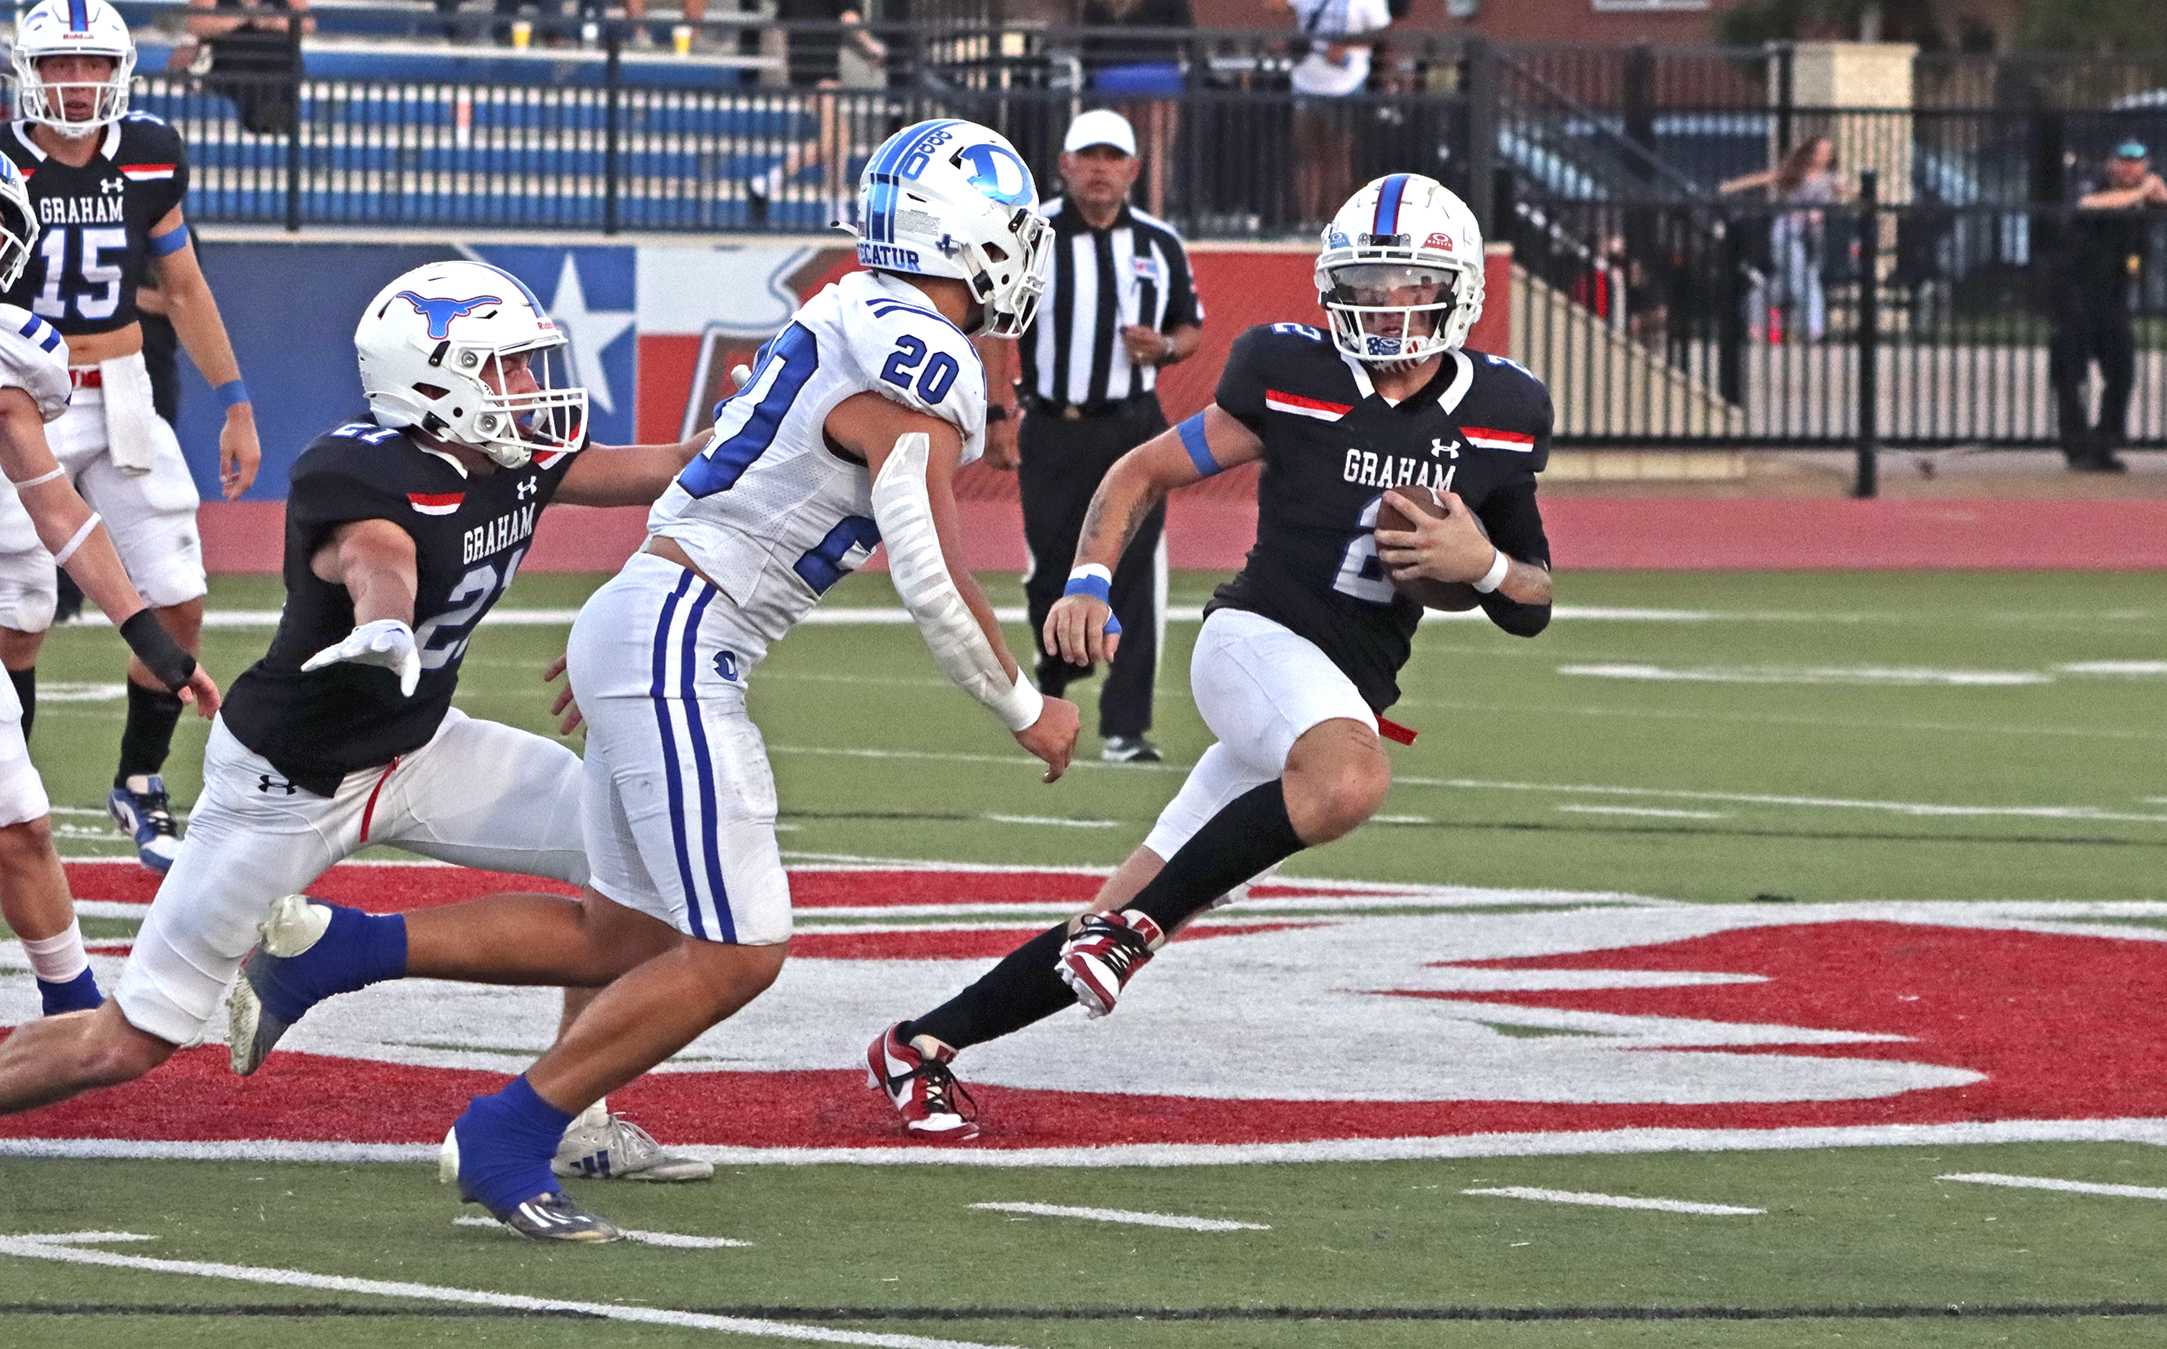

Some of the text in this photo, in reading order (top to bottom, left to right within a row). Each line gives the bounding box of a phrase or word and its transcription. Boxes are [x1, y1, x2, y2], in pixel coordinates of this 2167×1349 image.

[39, 196, 125, 224] GRAHAM
[31, 227, 128, 320] 15
[880, 334, 960, 406] 20
[1343, 447, 1457, 493] GRAHAM
[462, 501, 536, 566] GRAHAM
